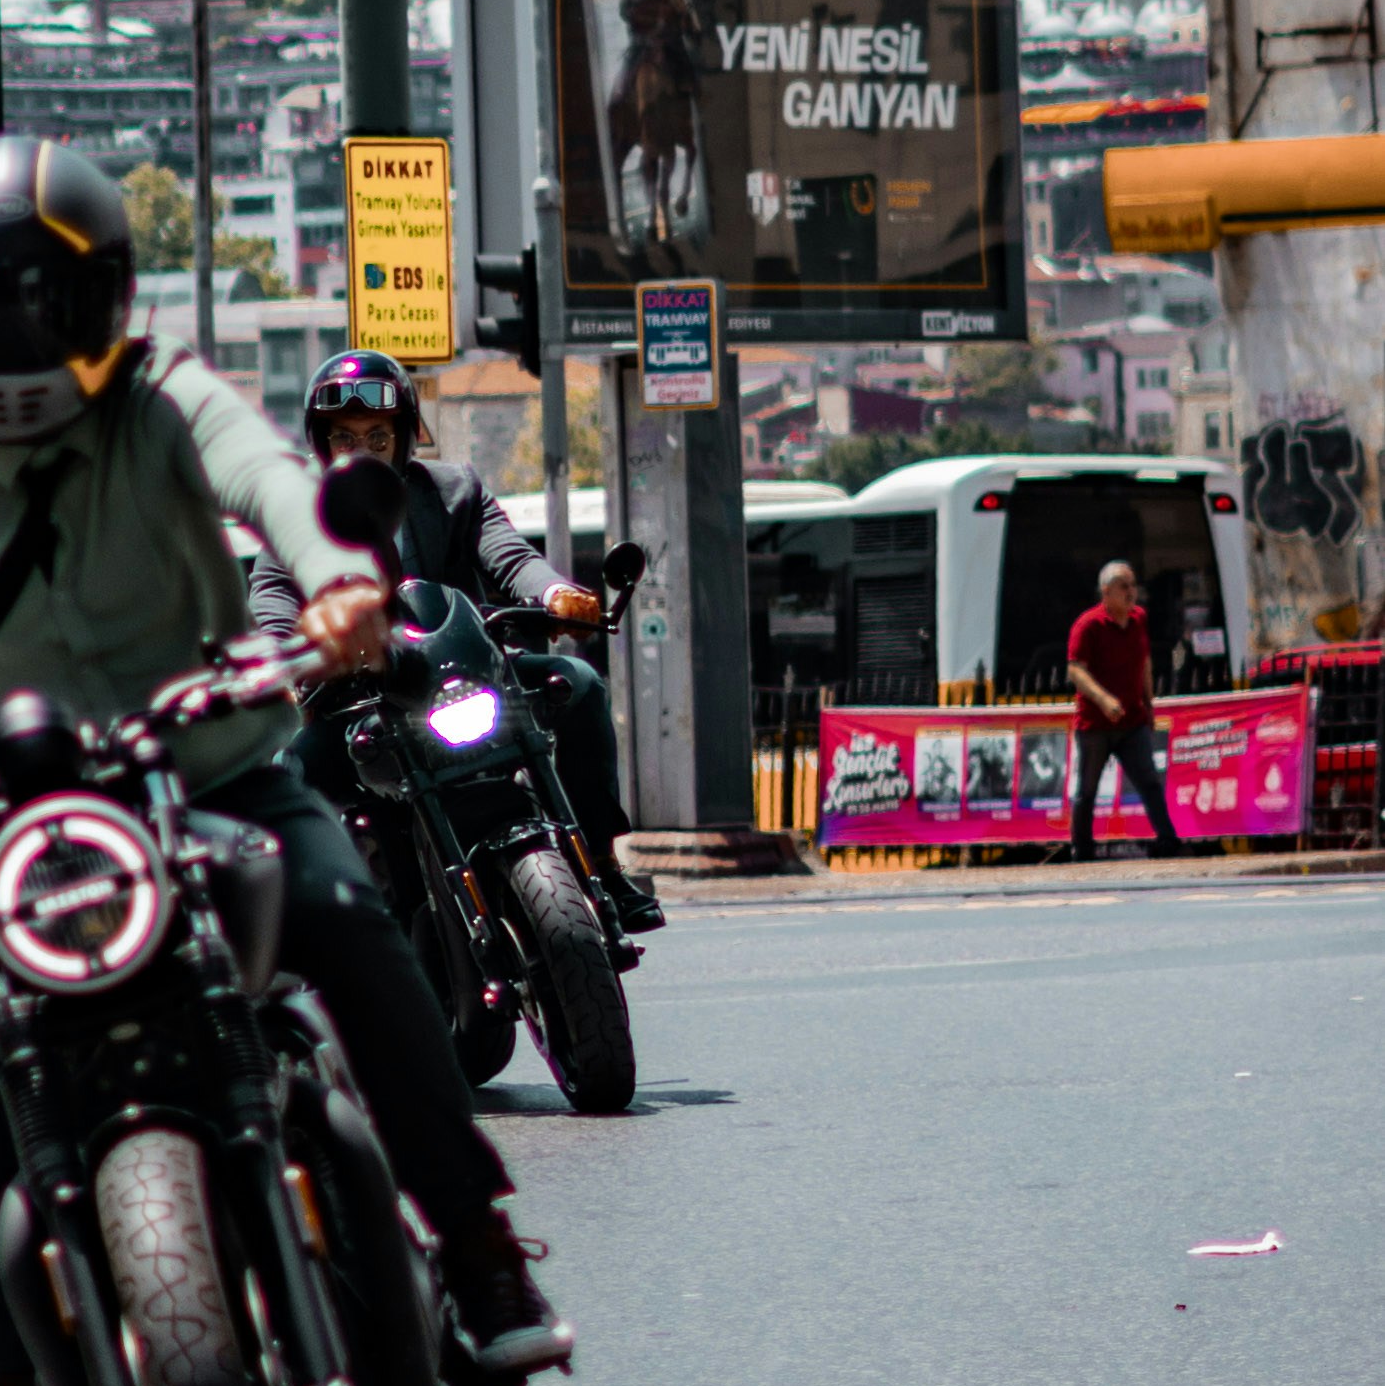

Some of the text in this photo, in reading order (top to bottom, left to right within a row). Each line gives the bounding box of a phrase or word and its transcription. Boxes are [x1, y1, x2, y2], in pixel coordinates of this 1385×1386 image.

[716, 19, 929, 74] YENİ NESİL
[782, 80, 958, 130] GANYAN
[363, 156, 433, 179] DİKKAT
[356, 192, 442, 215] Tramvay Yoluna
[357, 220, 443, 239] Girmek Yasaktır
[393, 266, 444, 291] EDS ile
[644, 291, 709, 309] DİKKAT
[367, 303, 439, 322] Para Cezası
[644, 312, 709, 327] TRAMVAY
[360, 330, 446, 350] Kesilmektedir
